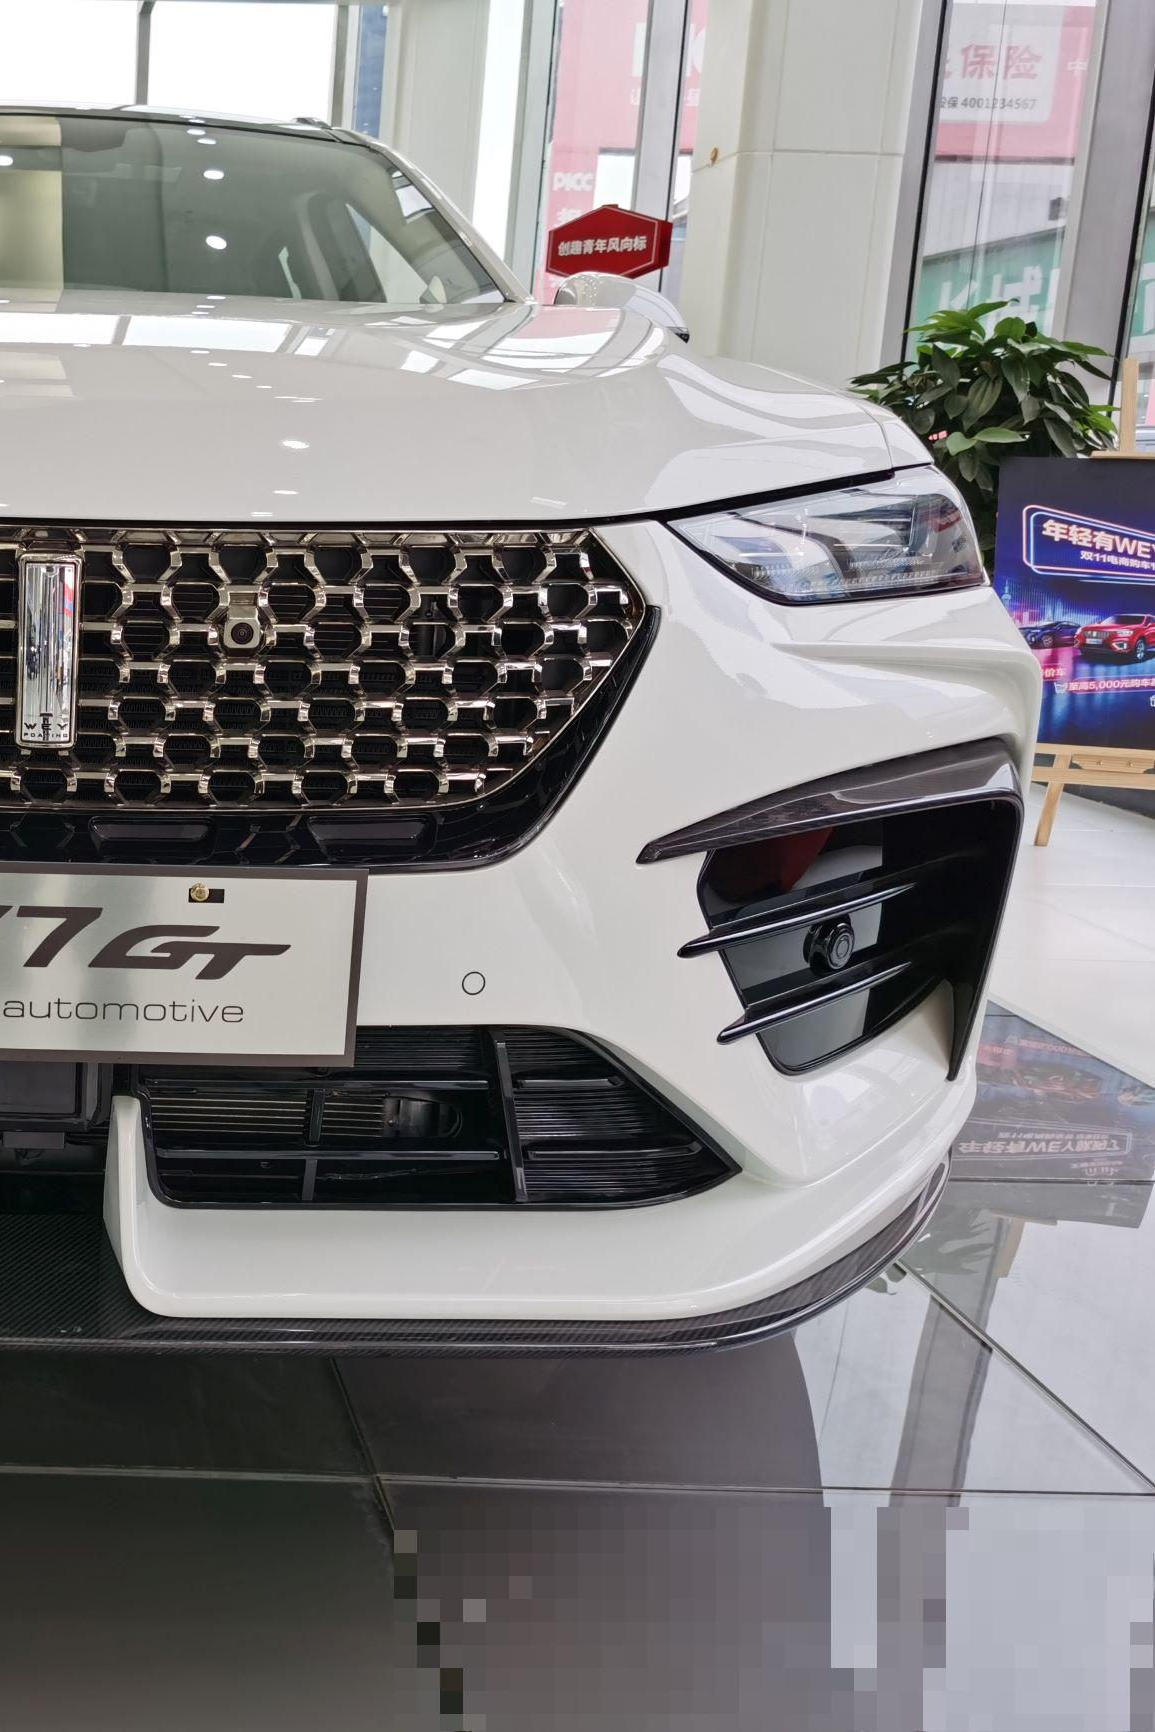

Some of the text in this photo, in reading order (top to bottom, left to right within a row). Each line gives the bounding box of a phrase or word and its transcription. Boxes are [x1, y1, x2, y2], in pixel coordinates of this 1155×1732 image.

[961, 97, 1037, 110] 4001234567
[558, 236, 647, 257] 创趣青年风向标
[1042, 519, 1155, 559] 年轻有WE
[1041, 667, 1067, 678] 价车
[2, 997, 245, 1023] automotive
